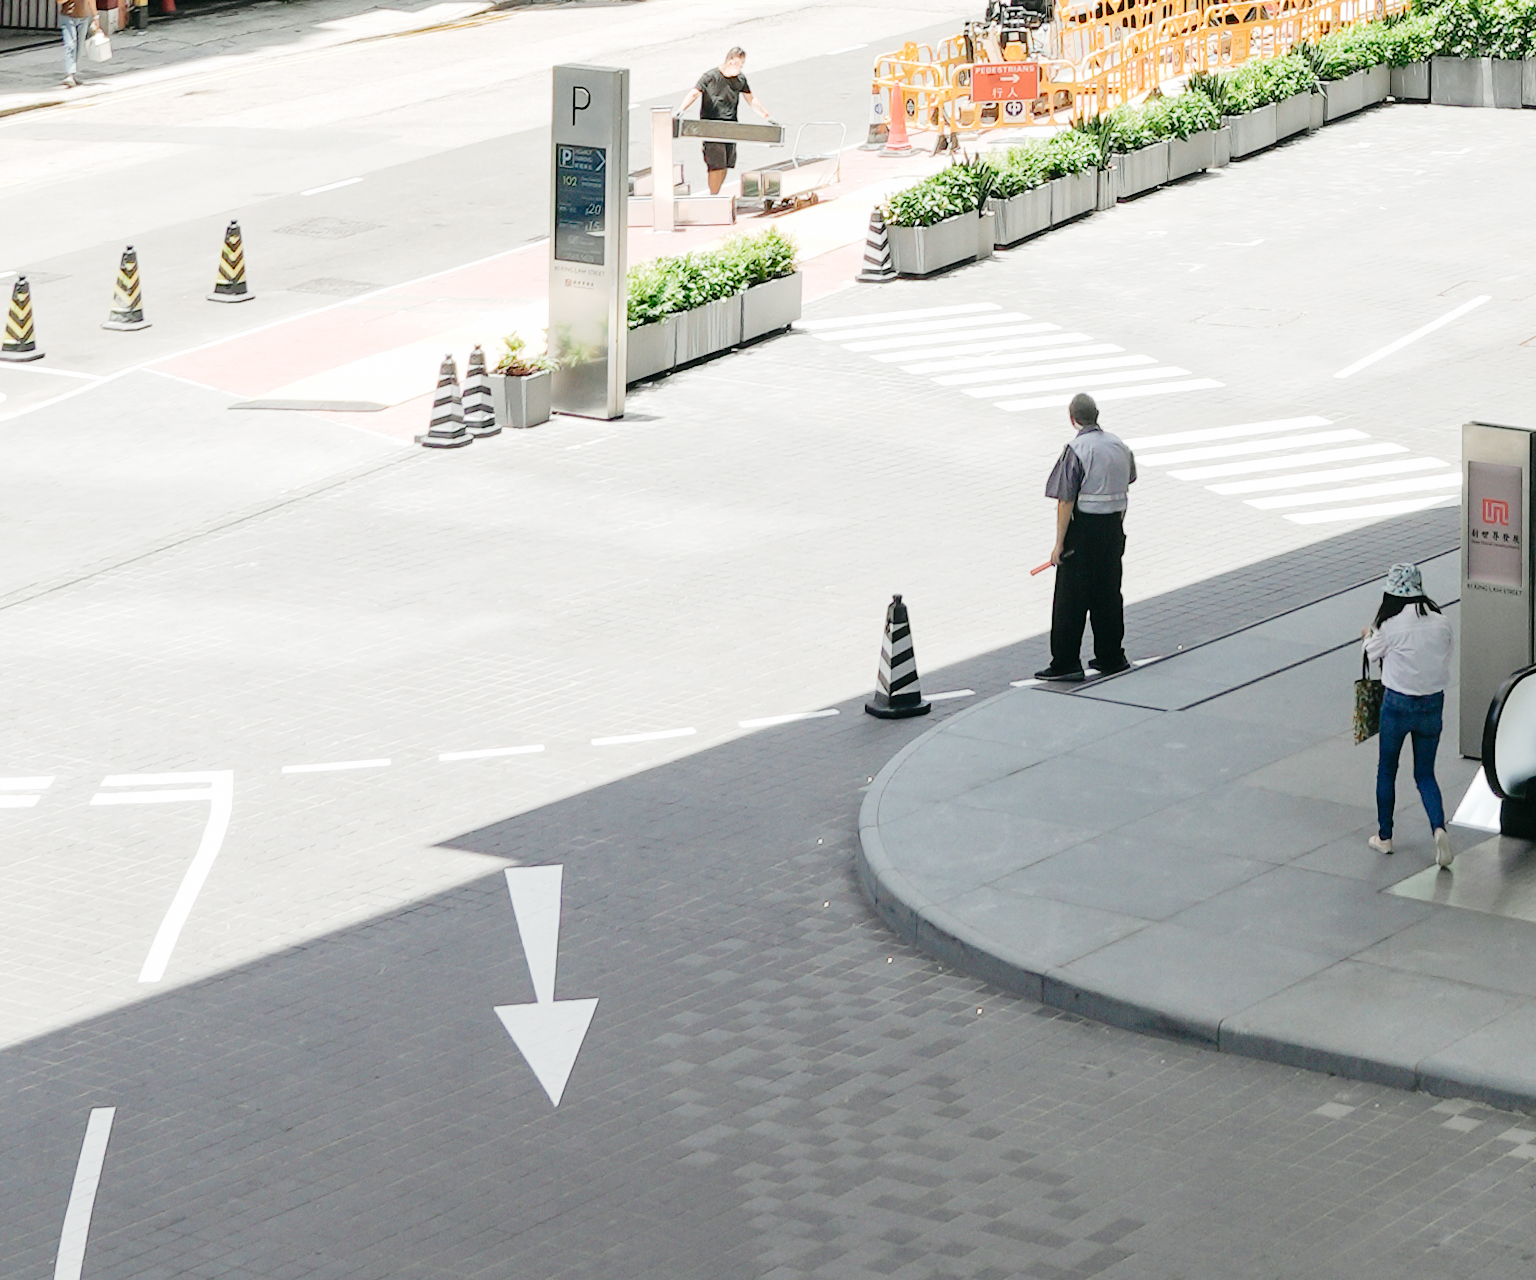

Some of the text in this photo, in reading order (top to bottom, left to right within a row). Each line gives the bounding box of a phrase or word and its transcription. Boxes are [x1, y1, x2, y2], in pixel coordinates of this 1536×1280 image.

[974, 65, 1035, 75] PEDESTRIANS
[992, 87, 1018, 98] 行人
[572, 86, 591, 126] P
[562, 150, 572, 166] P
